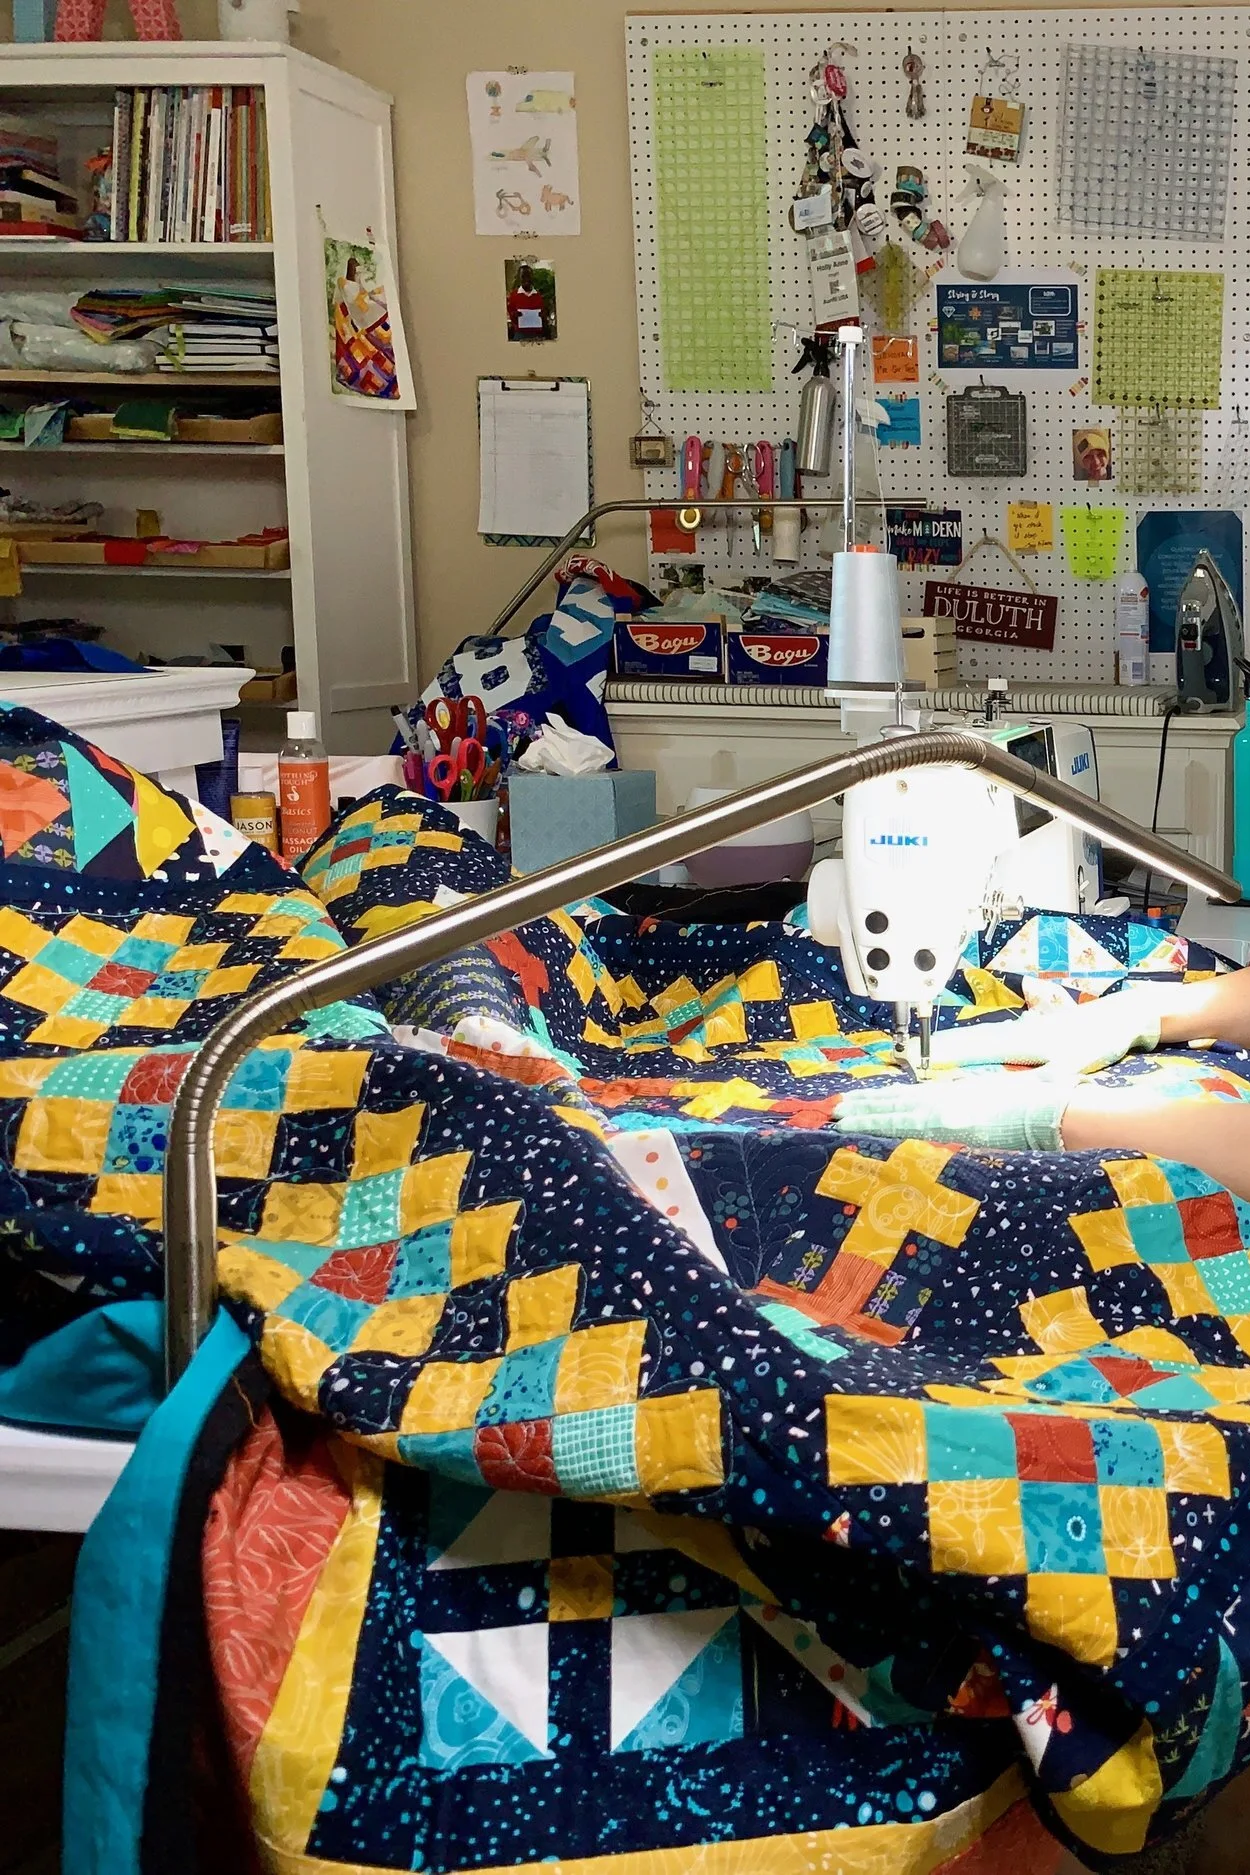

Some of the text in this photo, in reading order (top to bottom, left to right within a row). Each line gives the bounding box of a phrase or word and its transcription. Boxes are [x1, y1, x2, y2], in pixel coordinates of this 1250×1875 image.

[937, 585, 1047, 607] LIFE IS BETTER IN
[933, 596, 1044, 631] DULUTH
[957, 625, 1019, 639] GEORGIA
[1071, 752, 1090, 776] JUKI
[236, 820, 273, 831] JASON
[870, 834, 928, 847] JUKI
